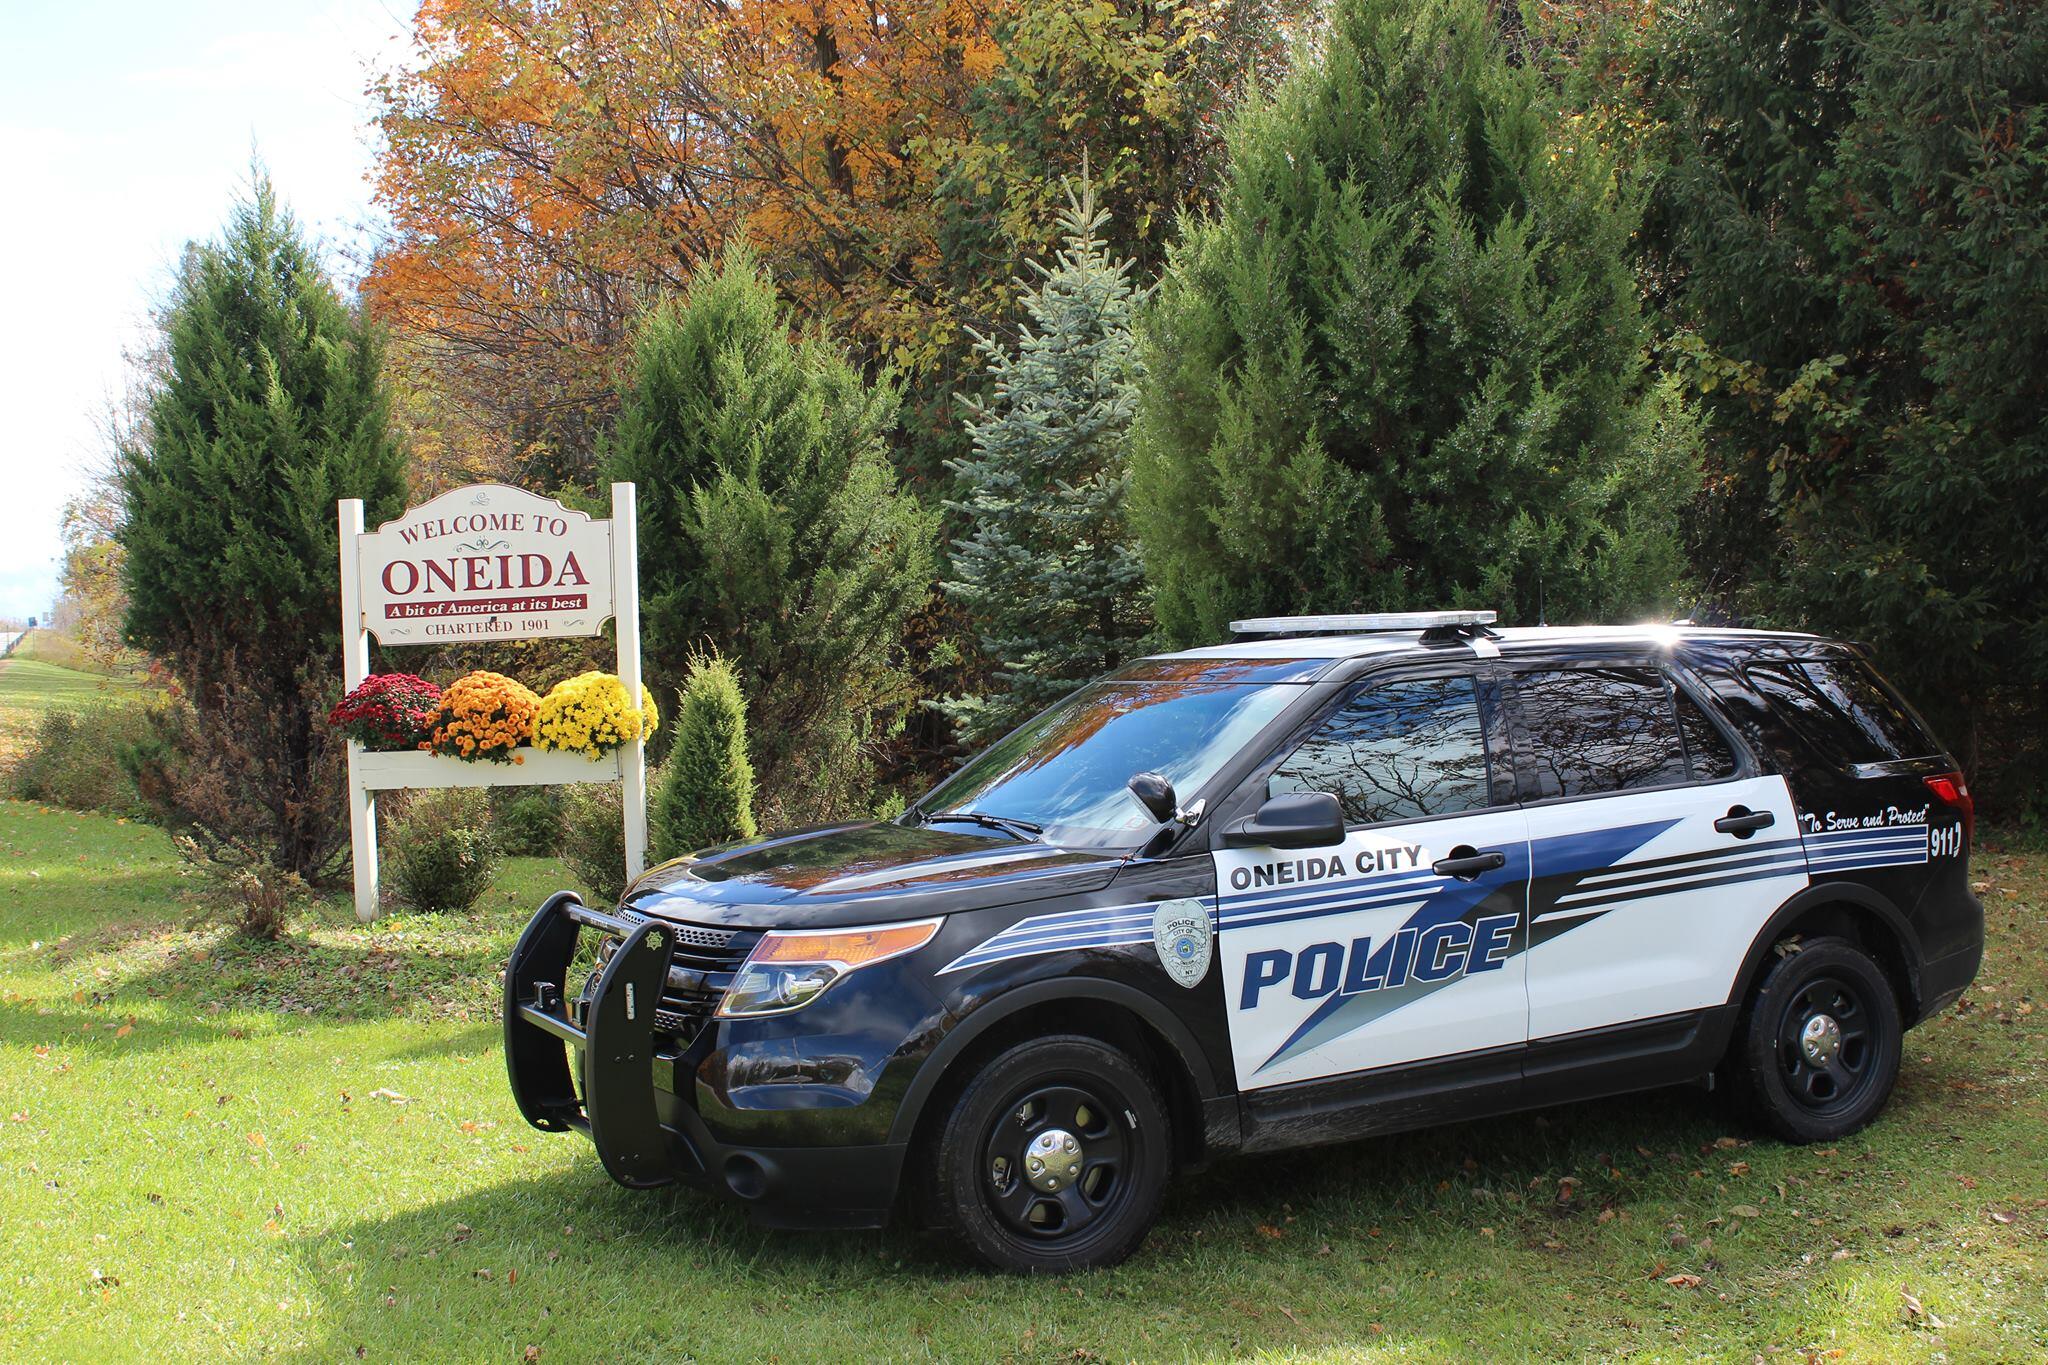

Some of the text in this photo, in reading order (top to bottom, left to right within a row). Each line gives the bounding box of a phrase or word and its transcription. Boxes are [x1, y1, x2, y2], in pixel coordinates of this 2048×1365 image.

[399, 513, 568, 545] WELCOME TO
[381, 550, 590, 596] ONEIDA
[389, 597, 582, 617] A bit of America at its best
[425, 619, 549, 636] CHARTERED 1901
[1826, 811, 1860, 830] Serve
[1862, 809, 1885, 827] and
[1931, 827, 1954, 857] 911
[1230, 844, 1422, 891] ONEIDA CITY
[1167, 919, 1196, 930] POLICE
[1173, 929, 1185, 937] CITY
[1239, 912, 1520, 1011] POLICE
